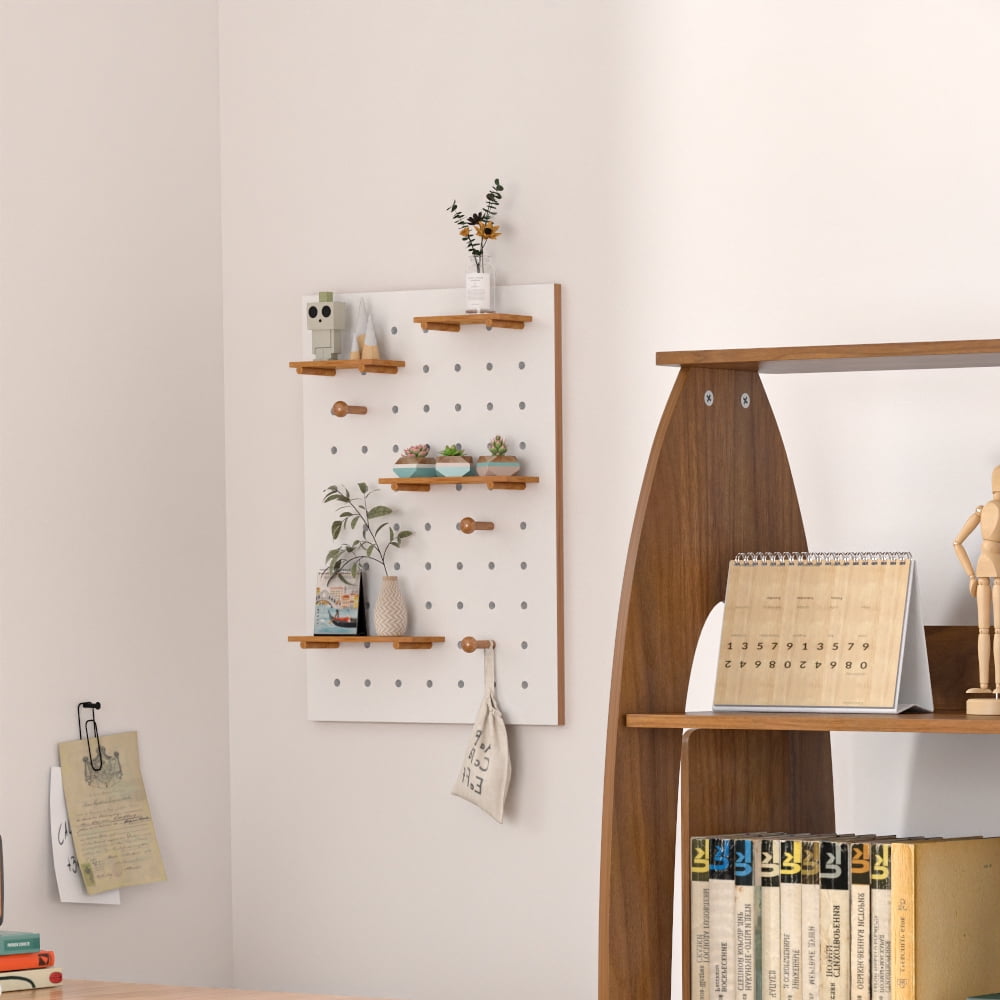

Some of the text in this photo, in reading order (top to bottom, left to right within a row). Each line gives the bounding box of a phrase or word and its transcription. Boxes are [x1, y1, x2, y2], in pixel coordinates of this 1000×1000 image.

[727, 642, 870, 650] 1 3 5 7 9 1 3 5 7 9
